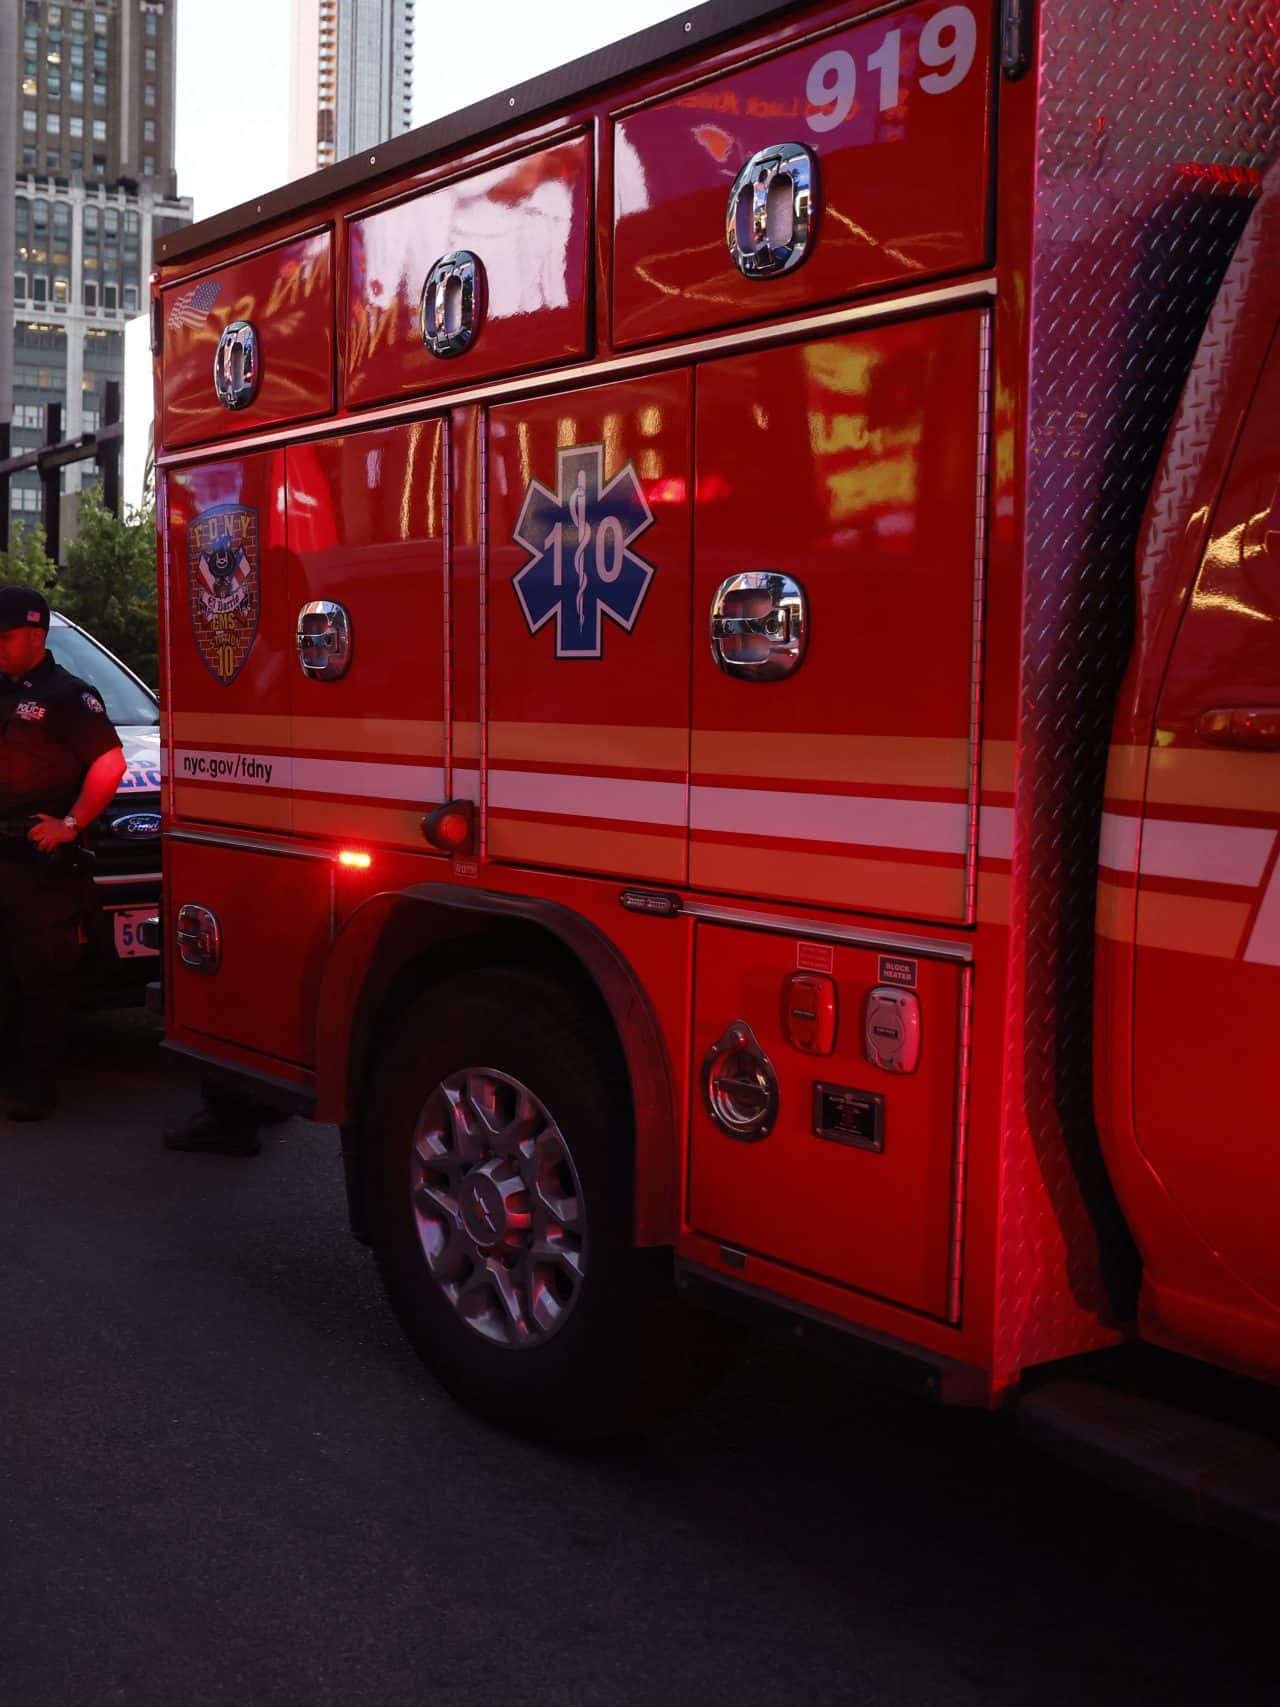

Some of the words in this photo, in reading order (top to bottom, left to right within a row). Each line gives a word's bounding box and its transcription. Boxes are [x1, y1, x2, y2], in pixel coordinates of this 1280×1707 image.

[805, 5, 977, 133] 919
[194, 514, 251, 548] FDNY
[544, 515, 624, 586] 10
[212, 612, 236, 630] EMS
[216, 646, 234, 677] 10
[16, 702, 47, 718] POLICE
[183, 753, 272, 783] nyc.gov/fdny
[883, 969, 912, 981] HEATER
[885, 961, 911, 973] BLOCK
